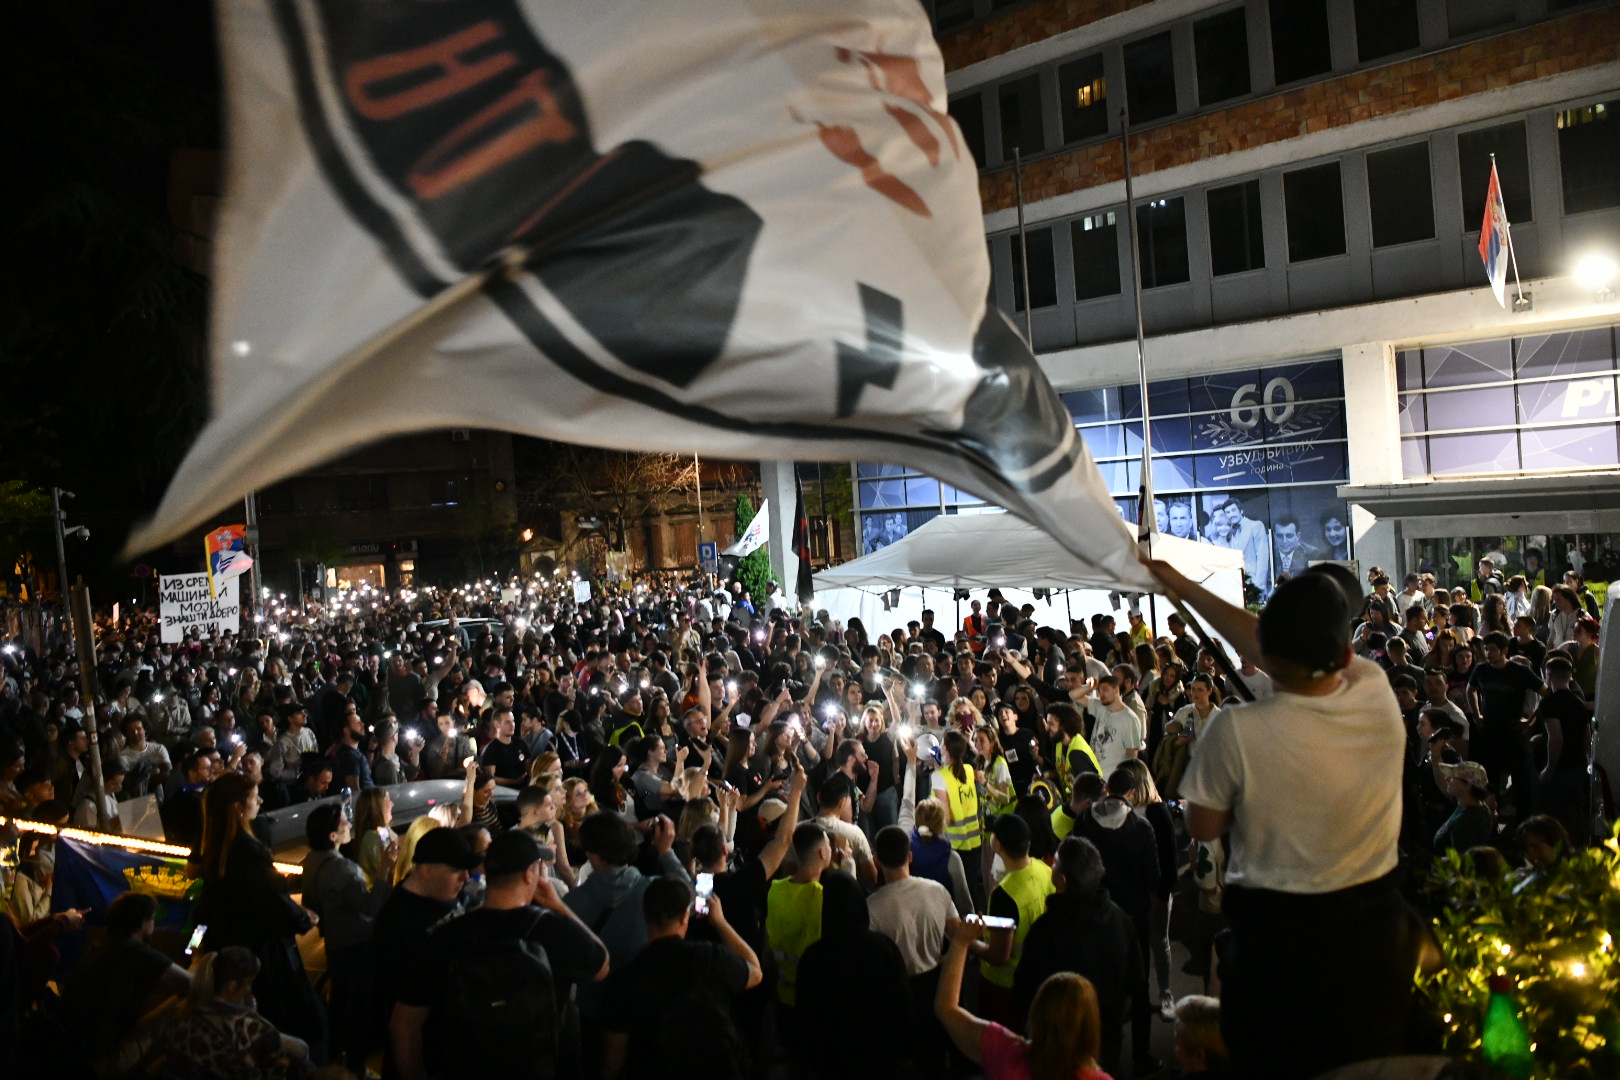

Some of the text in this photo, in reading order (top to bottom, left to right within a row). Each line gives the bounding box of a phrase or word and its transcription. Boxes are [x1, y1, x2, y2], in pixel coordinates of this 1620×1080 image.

[1230, 377, 1295, 430] 60
[164, 579, 184, 591] ИЗ
[181, 600, 220, 616] МОЈИ
